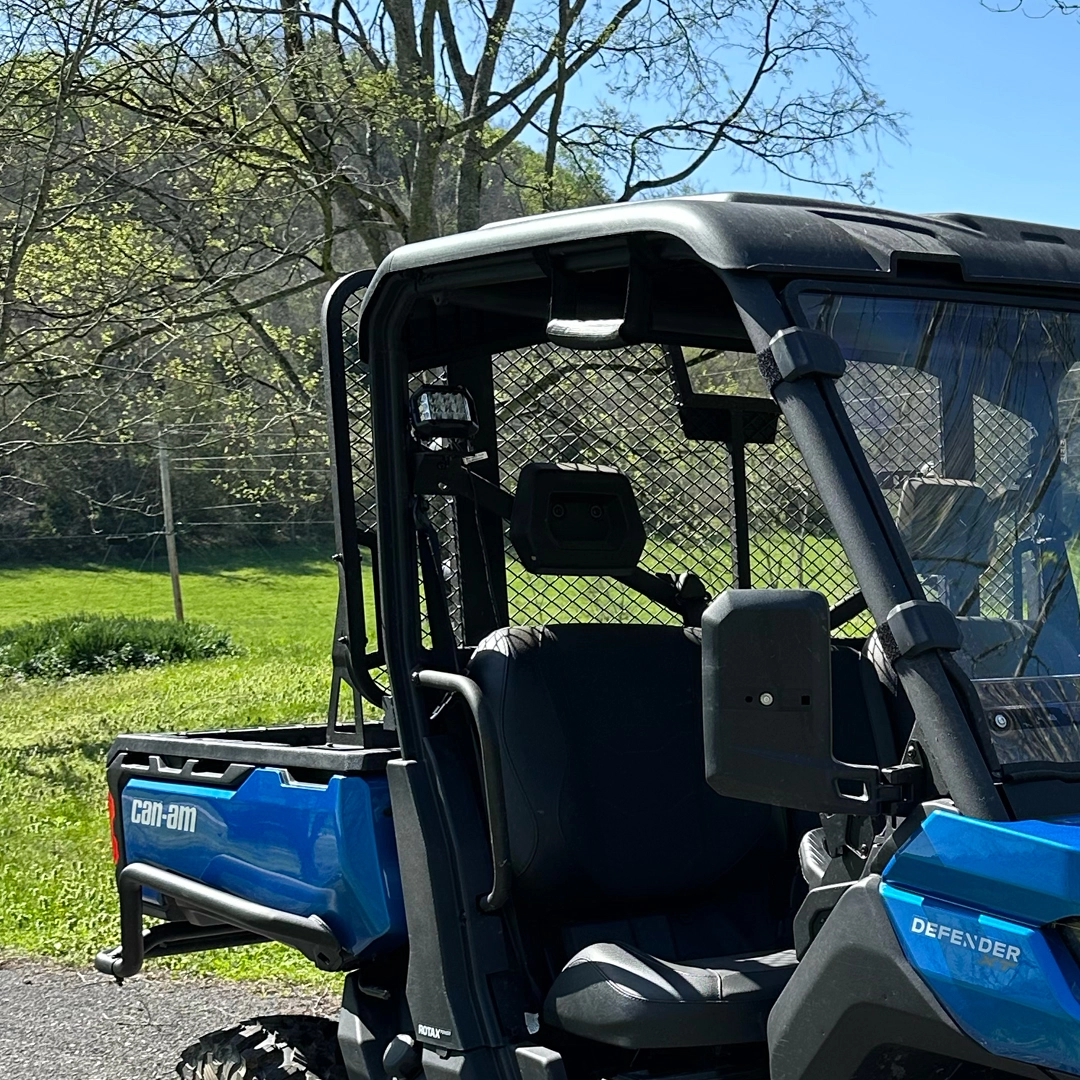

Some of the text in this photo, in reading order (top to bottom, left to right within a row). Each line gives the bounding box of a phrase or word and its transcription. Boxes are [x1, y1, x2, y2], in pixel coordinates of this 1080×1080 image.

[131, 799, 197, 832] can-am
[911, 917, 1020, 962] DEFENDER
[418, 1024, 440, 1039] ROTAX
